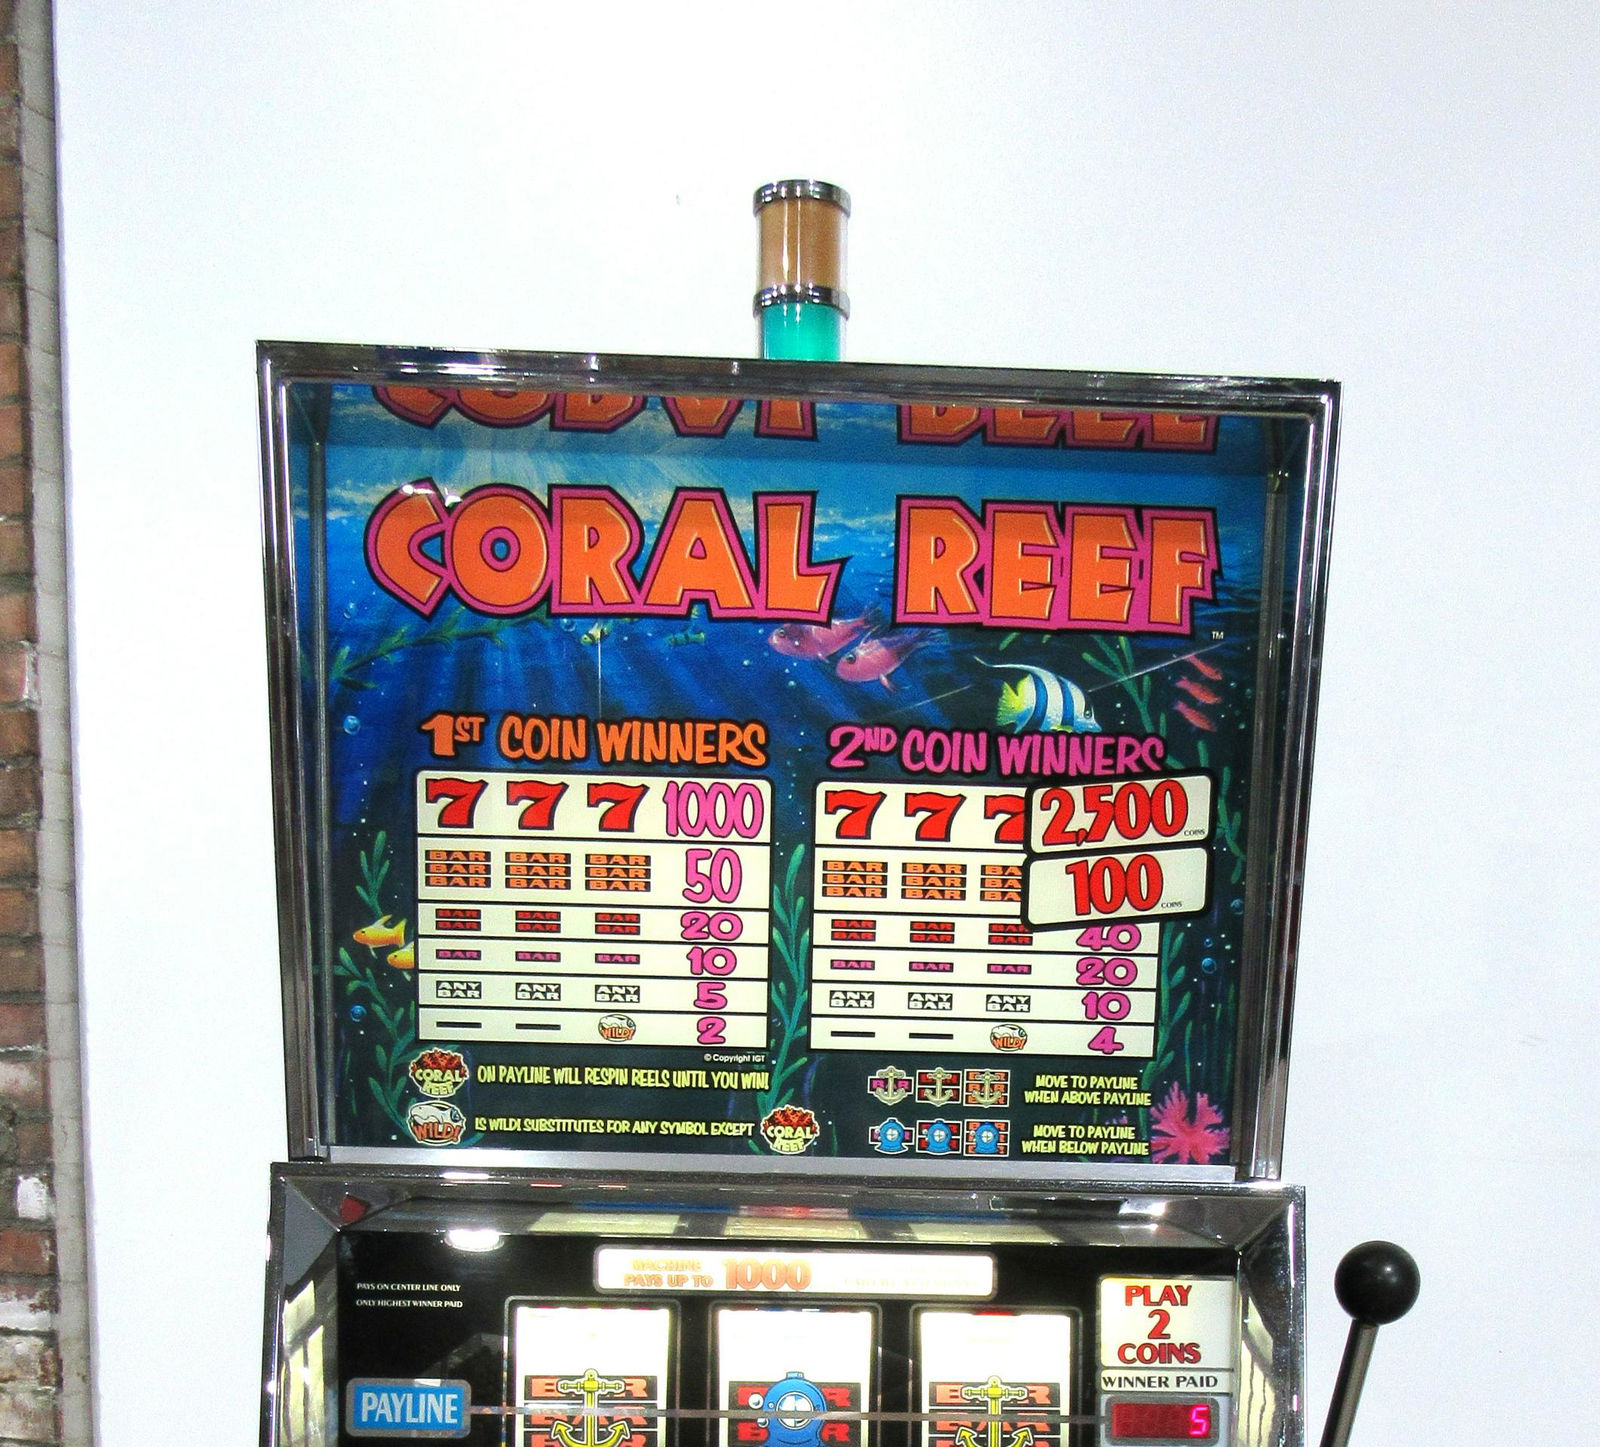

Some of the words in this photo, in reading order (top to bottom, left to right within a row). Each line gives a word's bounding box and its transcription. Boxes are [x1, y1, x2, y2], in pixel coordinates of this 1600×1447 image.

[364, 478, 845, 627] CORAL
[891, 494, 1223, 634] REEF
[421, 714, 484, 756] 1ST
[500, 715, 586, 760] COIN
[597, 721, 766, 766] WINNERS
[830, 726, 897, 767] 2ND
[902, 728, 987, 773] COIN
[425, 778, 488, 828] 7
[506, 780, 569, 830] 7
[587, 782, 650, 832] 7
[663, 781, 764, 838] 1000
[825, 790, 887, 840] 7
[905, 791, 966, 841] 7
[1040, 779, 1188, 846] 2,500
[1184, 829, 1205, 837] COINS
[430, 851, 486, 861] BAR
[510, 853, 566, 863] BAR
[589, 854, 646, 865] BAR
[826, 861, 883, 872] BAR
[905, 863, 962, 874] BAR
[430, 863, 486, 874] BAR
[510, 866, 566, 876] BAR
[589, 867, 646, 878] BAR
[682, 848, 742, 903] 50
[430, 876, 486, 886] BAR
[510, 878, 566, 889] BAR
[589, 880, 646, 891] BAR
[826, 874, 883, 885] BAR
[905, 876, 962, 887] BAR
[1066, 854, 1163, 915] 100
[1161, 901, 1182, 909] COINS
[826, 887, 883, 897] BAR
[905, 889, 962, 899] BAR
[437, 910, 478, 918] BAR
[517, 912, 559, 920] BAR
[596, 914, 638, 922] BAR
[681, 911, 743, 941] 20
[437, 921, 478, 929] BAR
[517, 923, 559, 931] BAR
[596, 925, 638, 934] BAR
[833, 920, 873, 928] BAR
[912, 922, 953, 930] BAR
[1075, 923, 1142, 951] 40
[833, 932, 873, 940] BAR
[912, 934, 953, 942] BAR
[990, 936, 1030, 944] BAR
[438, 951, 479, 959] BAR
[517, 953, 558, 961] BAR
[597, 954, 638, 963] BAR
[686, 945, 737, 976] 10
[832, 960, 873, 969] BAR
[911, 963, 951, 971] BAR
[989, 965, 1029, 973] BAR
[1076, 956, 1138, 987] 20
[438, 982, 480, 990] ANY
[518, 984, 559, 992] ANY
[597, 986, 638, 994] ANY
[693, 981, 728, 1010] 5
[438, 990, 480, 998] BAR
[517, 991, 559, 999] BAR
[596, 994, 639, 1002] BAR
[832, 991, 873, 1000] ANY
[910, 993, 951, 1002] ANY
[988, 995, 1029, 1004] ANY
[1081, 991, 1131, 1020] 10
[831, 1000, 873, 1008] BAR
[909, 1001, 951, 1010] BAR
[987, 1003, 1029, 1012] BAR
[697, 1016, 726, 1044] 2
[1087, 1026, 1124, 1055] 4
[713, 1054, 751, 1063] Copyright
[415, 1068, 462, 1082] CORAL
[477, 1065, 496, 1083] ON
[498, 1065, 551, 1084] PAYLINE
[553, 1067, 582, 1085] WILL
[584, 1067, 628, 1086] RESPIN
[632, 1069, 670, 1087] REELS
[672, 1071, 709, 1088] UNTIL
[713, 1072, 738, 1089] YOU
[741, 1072, 769, 1090] WIN!
[1035, 1075, 1068, 1088] MOVE
[1070, 1075, 1087, 1088] TO
[1089, 1076, 1138, 1090] PAYLINE
[422, 1081, 454, 1095] REEF
[1024, 1090, 1059, 1103] WHEN
[1061, 1091, 1101, 1105] ABOVE
[1103, 1092, 1152, 1106] PAYLINE
[413, 1122, 462, 1142] WILD!
[475, 1117, 487, 1131] IS
[523, 1118, 605, 1133] SUBSTITUTES
[606, 1120, 631, 1133] FOR
[632, 1121, 657, 1134] ANY
[660, 1121, 709, 1136] SYMBOL
[710, 1122, 755, 1136] EXCEPT
[766, 1125, 813, 1139] CORAL
[1033, 1125, 1066, 1138] MOVE
[1068, 1125, 1085, 1138] TO
[1087, 1126, 1136, 1140] PAYLINE
[772, 1137, 805, 1152] REEF
[1021, 1140, 1056, 1153] WHEN
[1059, 1141, 1099, 1154] BELOW
[1101, 1142, 1149, 1155] PAYLINE
[623, 1274, 663, 1287] PAYS
[667, 1274, 689, 1288] UP
[692, 1275, 714, 1288] TO
[721, 1258, 812, 1291] 1000
[391, 1283, 421, 1291] CENTER
[440, 1284, 461, 1292] ONLY
[1125, 1285, 1192, 1306] PLAY
[377, 1299, 411, 1307] HIGHEST
[444, 1300, 463, 1308] PAID
[1147, 1309, 1171, 1340] 2
[1117, 1342, 1202, 1364] COINS
[1102, 1375, 1170, 1389] WINNER
[1175, 1376, 1218, 1389] PAID
[361, 1391, 458, 1424] PAYLINE
[1190, 1404, 1211, 1436] 5
